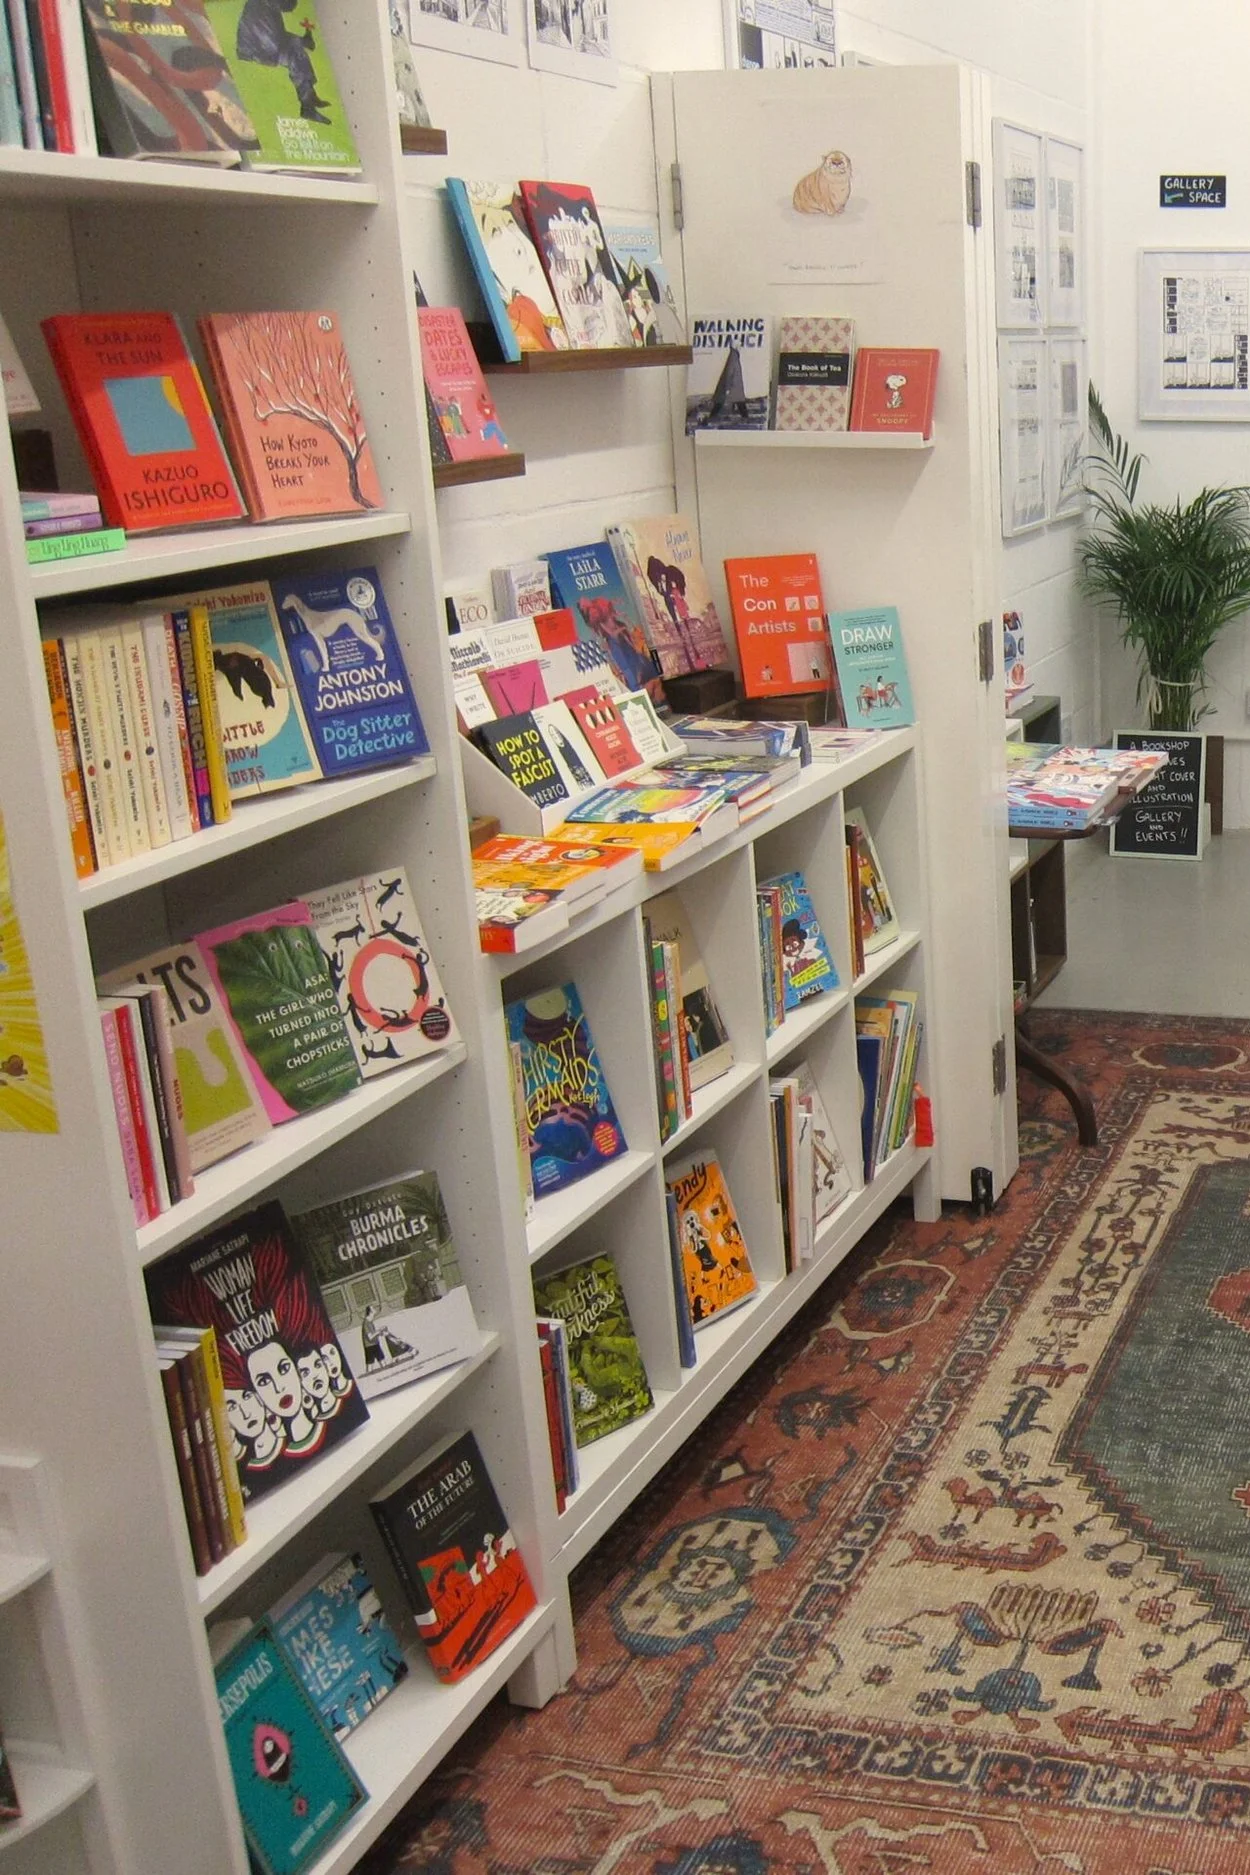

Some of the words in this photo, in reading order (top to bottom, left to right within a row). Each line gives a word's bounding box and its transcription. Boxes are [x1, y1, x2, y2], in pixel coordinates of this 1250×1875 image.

[276, 116, 308, 130] James
[1164, 177, 1214, 190] GALLERY
[1189, 192, 1222, 204] SPACE
[693, 318, 765, 334] WALKING
[84, 333, 133, 346] KLARA
[425, 329, 463, 346] DATES
[130, 350, 164, 365] SUN
[788, 364, 800, 372] The
[801, 364, 818, 372] Book
[820, 364, 828, 372] of
[260, 437, 286, 453] HOW
[303, 454, 331, 470] YOUR
[141, 466, 199, 485] KAZUO
[272, 473, 305, 489] HEART
[124, 480, 230, 513] ISHIGURO
[575, 571, 609, 592] STARR
[738, 574, 770, 589] The
[460, 605, 488, 624] ECO
[743, 598, 778, 613] Con
[747, 618, 797, 635] Artists
[840, 625, 894, 644] DRAW
[843, 642, 895, 656] STRONGER
[318, 663, 388, 692] ANTONY
[314, 679, 404, 712] JOHNSTON
[324, 723, 358, 744] Dog
[360, 712, 412, 732] Sitter
[335, 730, 416, 760] Detective
[495, 736, 522, 756] HOW
[523, 729, 540, 744] TO
[1130, 742, 1136, 750] A
[1142, 741, 1190, 751] BOOKSHOP
[508, 751, 535, 770] SPOT
[536, 748, 545, 759] A
[511, 759, 556, 789] FASCIST
[1169, 772, 1196, 781] COVER
[1147, 784, 1165, 792] AND
[1135, 810, 1181, 823] GALLERY
[1135, 831, 1176, 841] EVENTS
[342, 890, 358, 902] Like
[345, 901, 360, 914] Sky
[304, 973, 329, 989] ASA:
[256, 1007, 278, 1025] THE
[279, 999, 305, 1019] GIRL
[306, 988, 334, 1008] WHO
[269, 1017, 312, 1039] TURNED
[314, 1004, 339, 1022] INTO
[293, 1037, 302, 1050] A
[303, 1026, 329, 1045] PAIR
[330, 1021, 344, 1034] OF
[286, 1036, 350, 1070] CHOPSTICKS
[522, 1013, 585, 1096] HIRSTY
[103, 1023, 119, 1065] SEND
[111, 1071, 130, 1126] NUDES
[170, 1078, 185, 1120] NUDES
[526, 1047, 600, 1135] ERMAIDS
[675, 1162, 708, 1210] endy
[351, 1204, 406, 1236] BURMA
[338, 1215, 429, 1261] CHRONICLES
[203, 1255, 257, 1300] WOMAN
[226, 1288, 256, 1325] LIFE
[224, 1309, 281, 1356] FREEDOM
[407, 1488, 438, 1519] THE
[440, 1460, 472, 1496] ARAB
[415, 1518, 427, 1530] OF
[428, 1503, 444, 1520] THE
[444, 1475, 474, 1505] FUTURE
